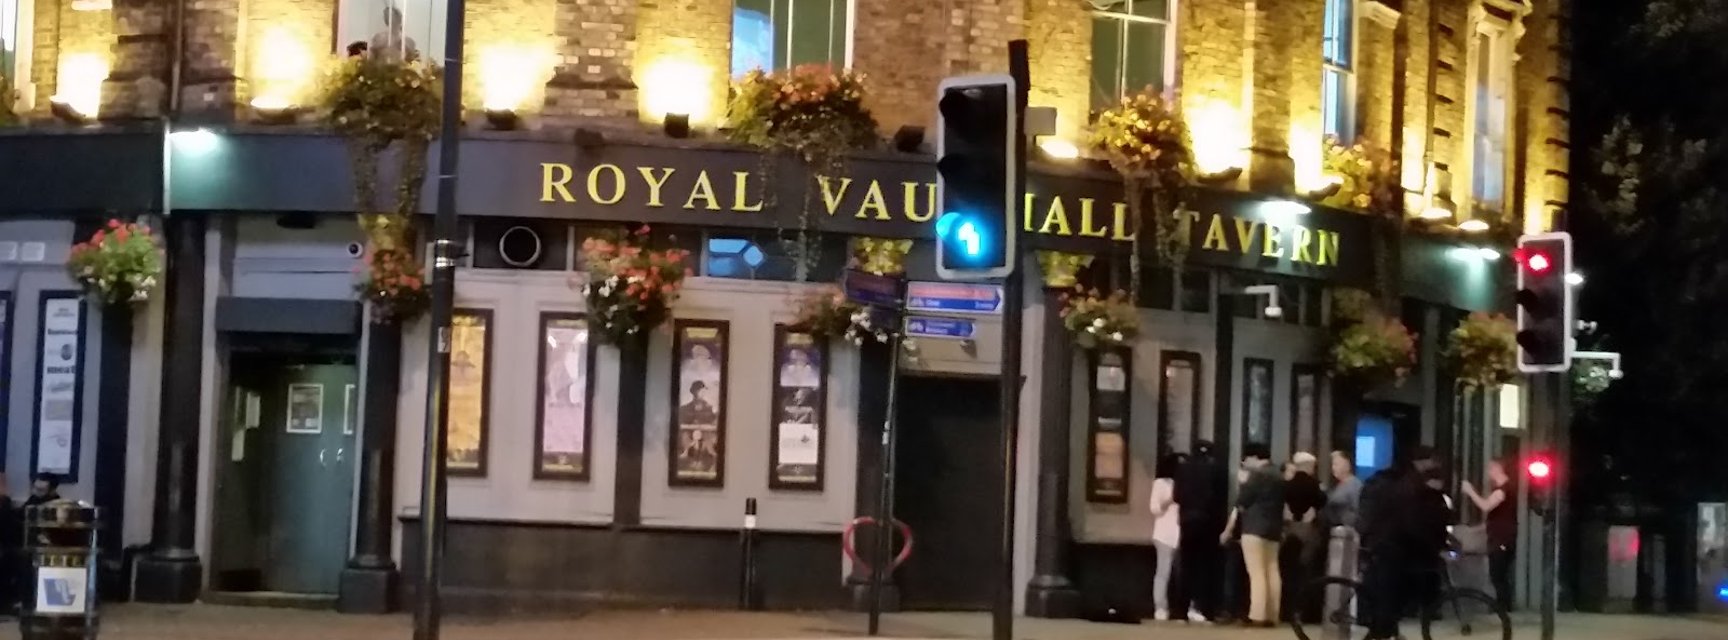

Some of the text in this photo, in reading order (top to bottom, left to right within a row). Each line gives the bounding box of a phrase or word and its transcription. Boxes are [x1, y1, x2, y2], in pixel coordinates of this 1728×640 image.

[540, 162, 1340, 266] ROYAL VAUALL TAVERN
